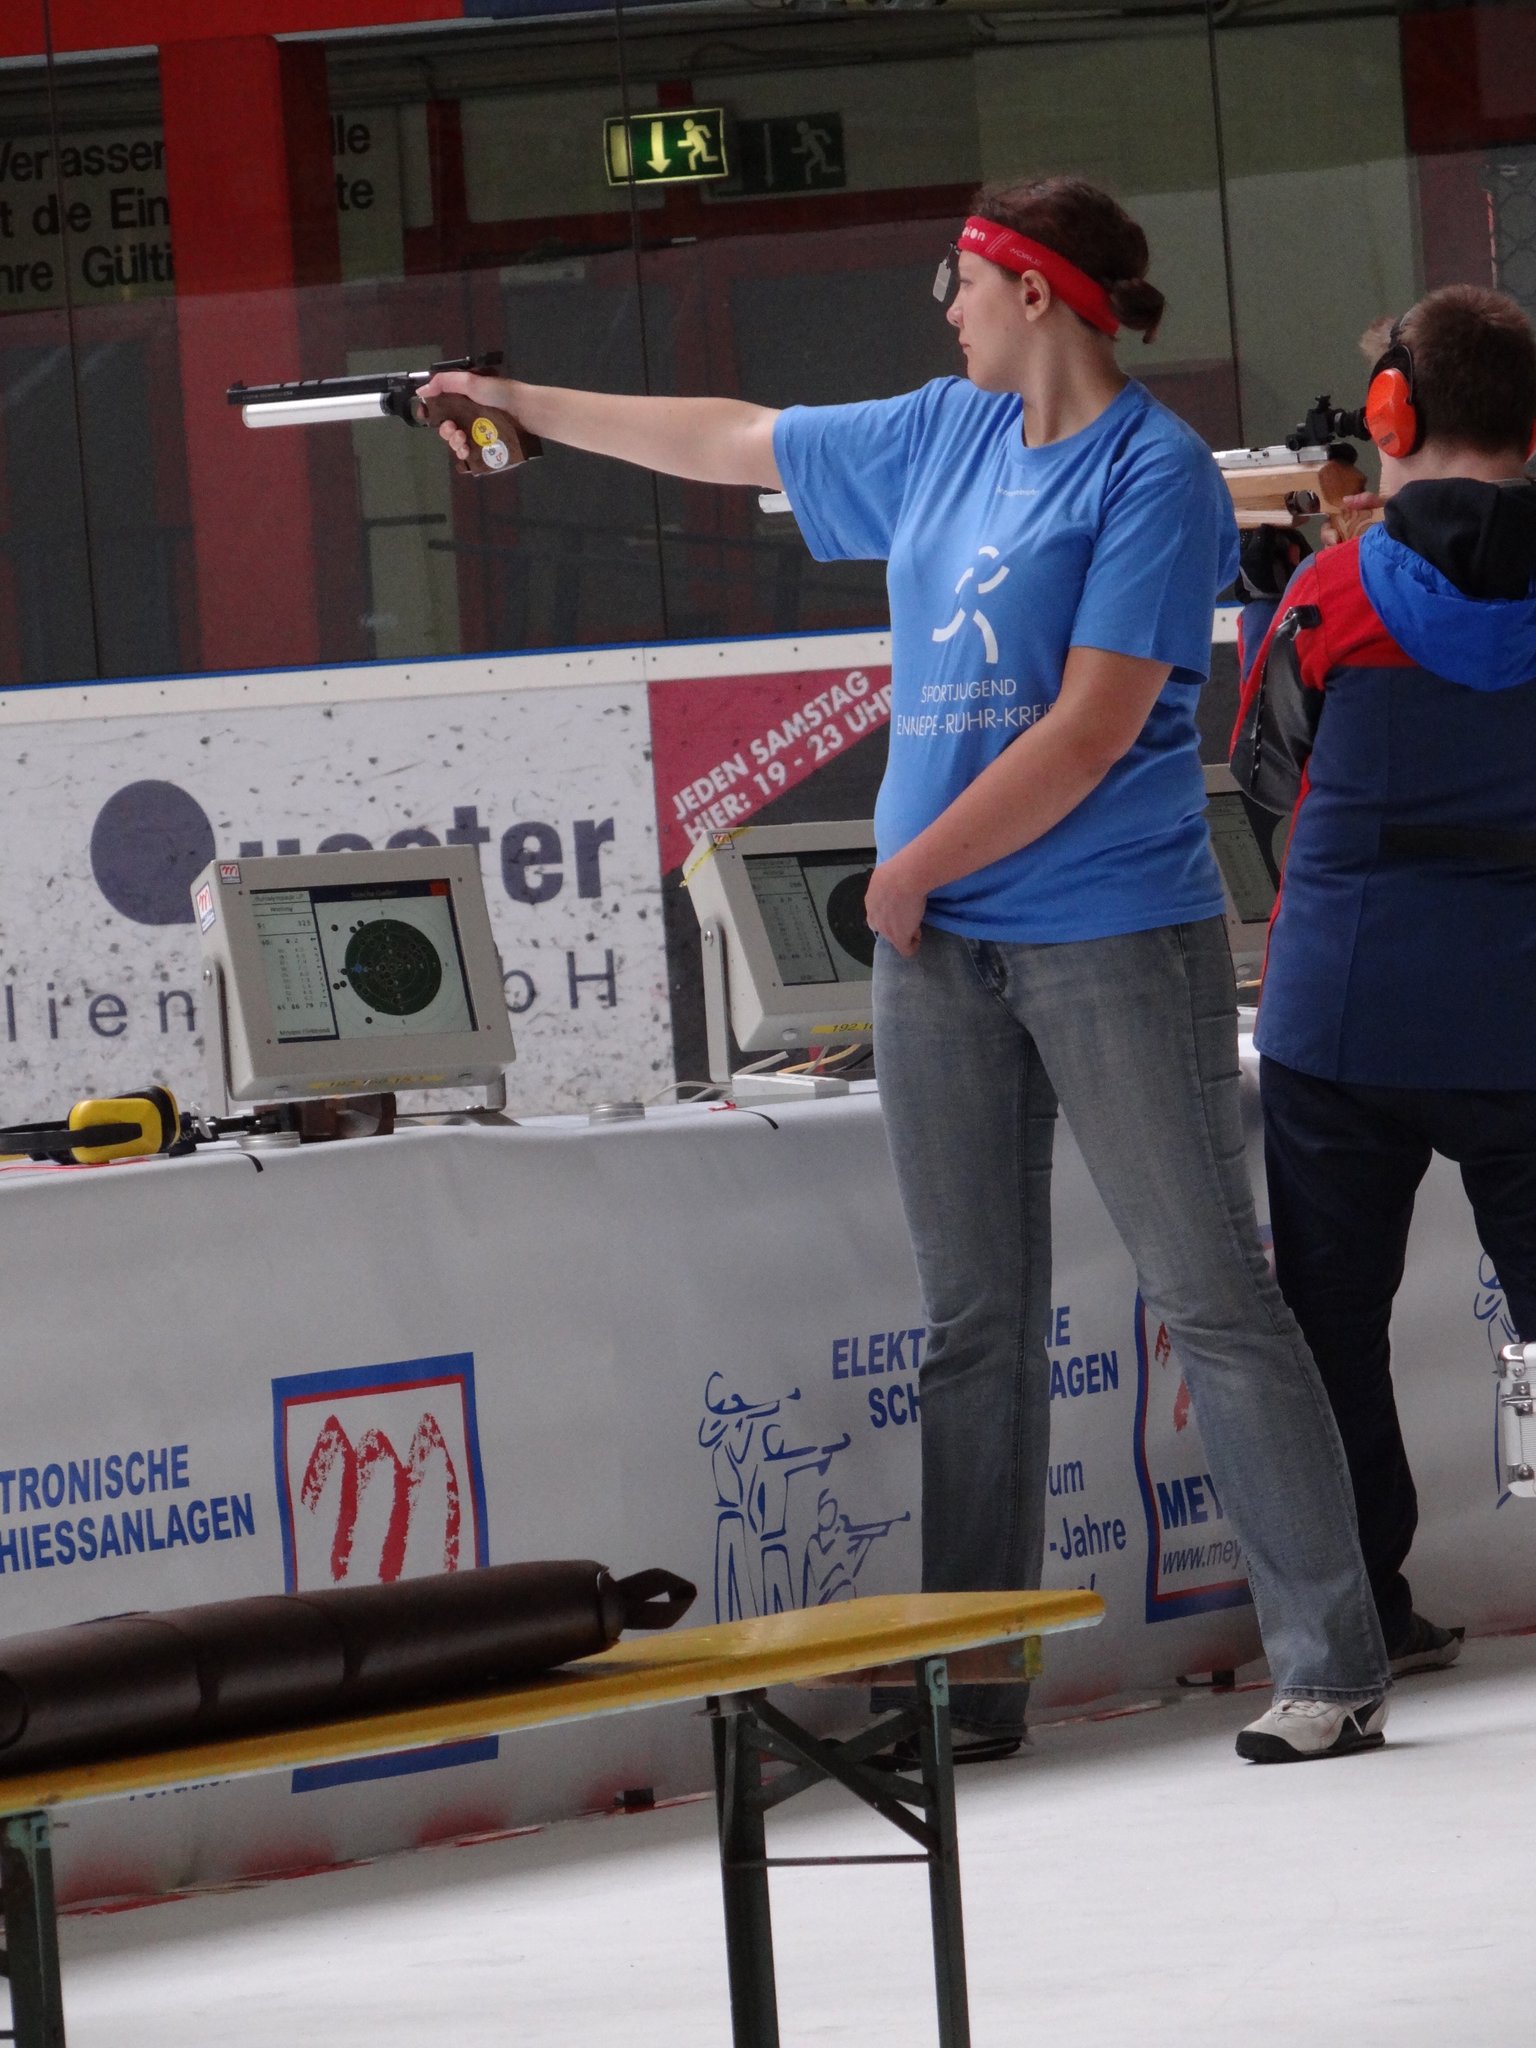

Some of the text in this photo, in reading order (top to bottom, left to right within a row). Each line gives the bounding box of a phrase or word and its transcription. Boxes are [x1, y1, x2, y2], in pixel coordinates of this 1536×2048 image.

[921, 678, 1017, 703] SPORTJUGEND
[672, 671, 869, 820] JEDEN SAMSTAG
[683, 792, 752, 846] HIER:
[753, 761, 787, 796] 19
[807, 724, 844, 762] 23
[832, 1328, 925, 1380] ELEKT
[868, 1350, 1118, 1428] SCH AGEN
[0, 1445, 190, 1514] TRONISCHE
[0, 1493, 255, 1574] HIESSANLAGEN
[1049, 1513, 1127, 1560] -Jahre
